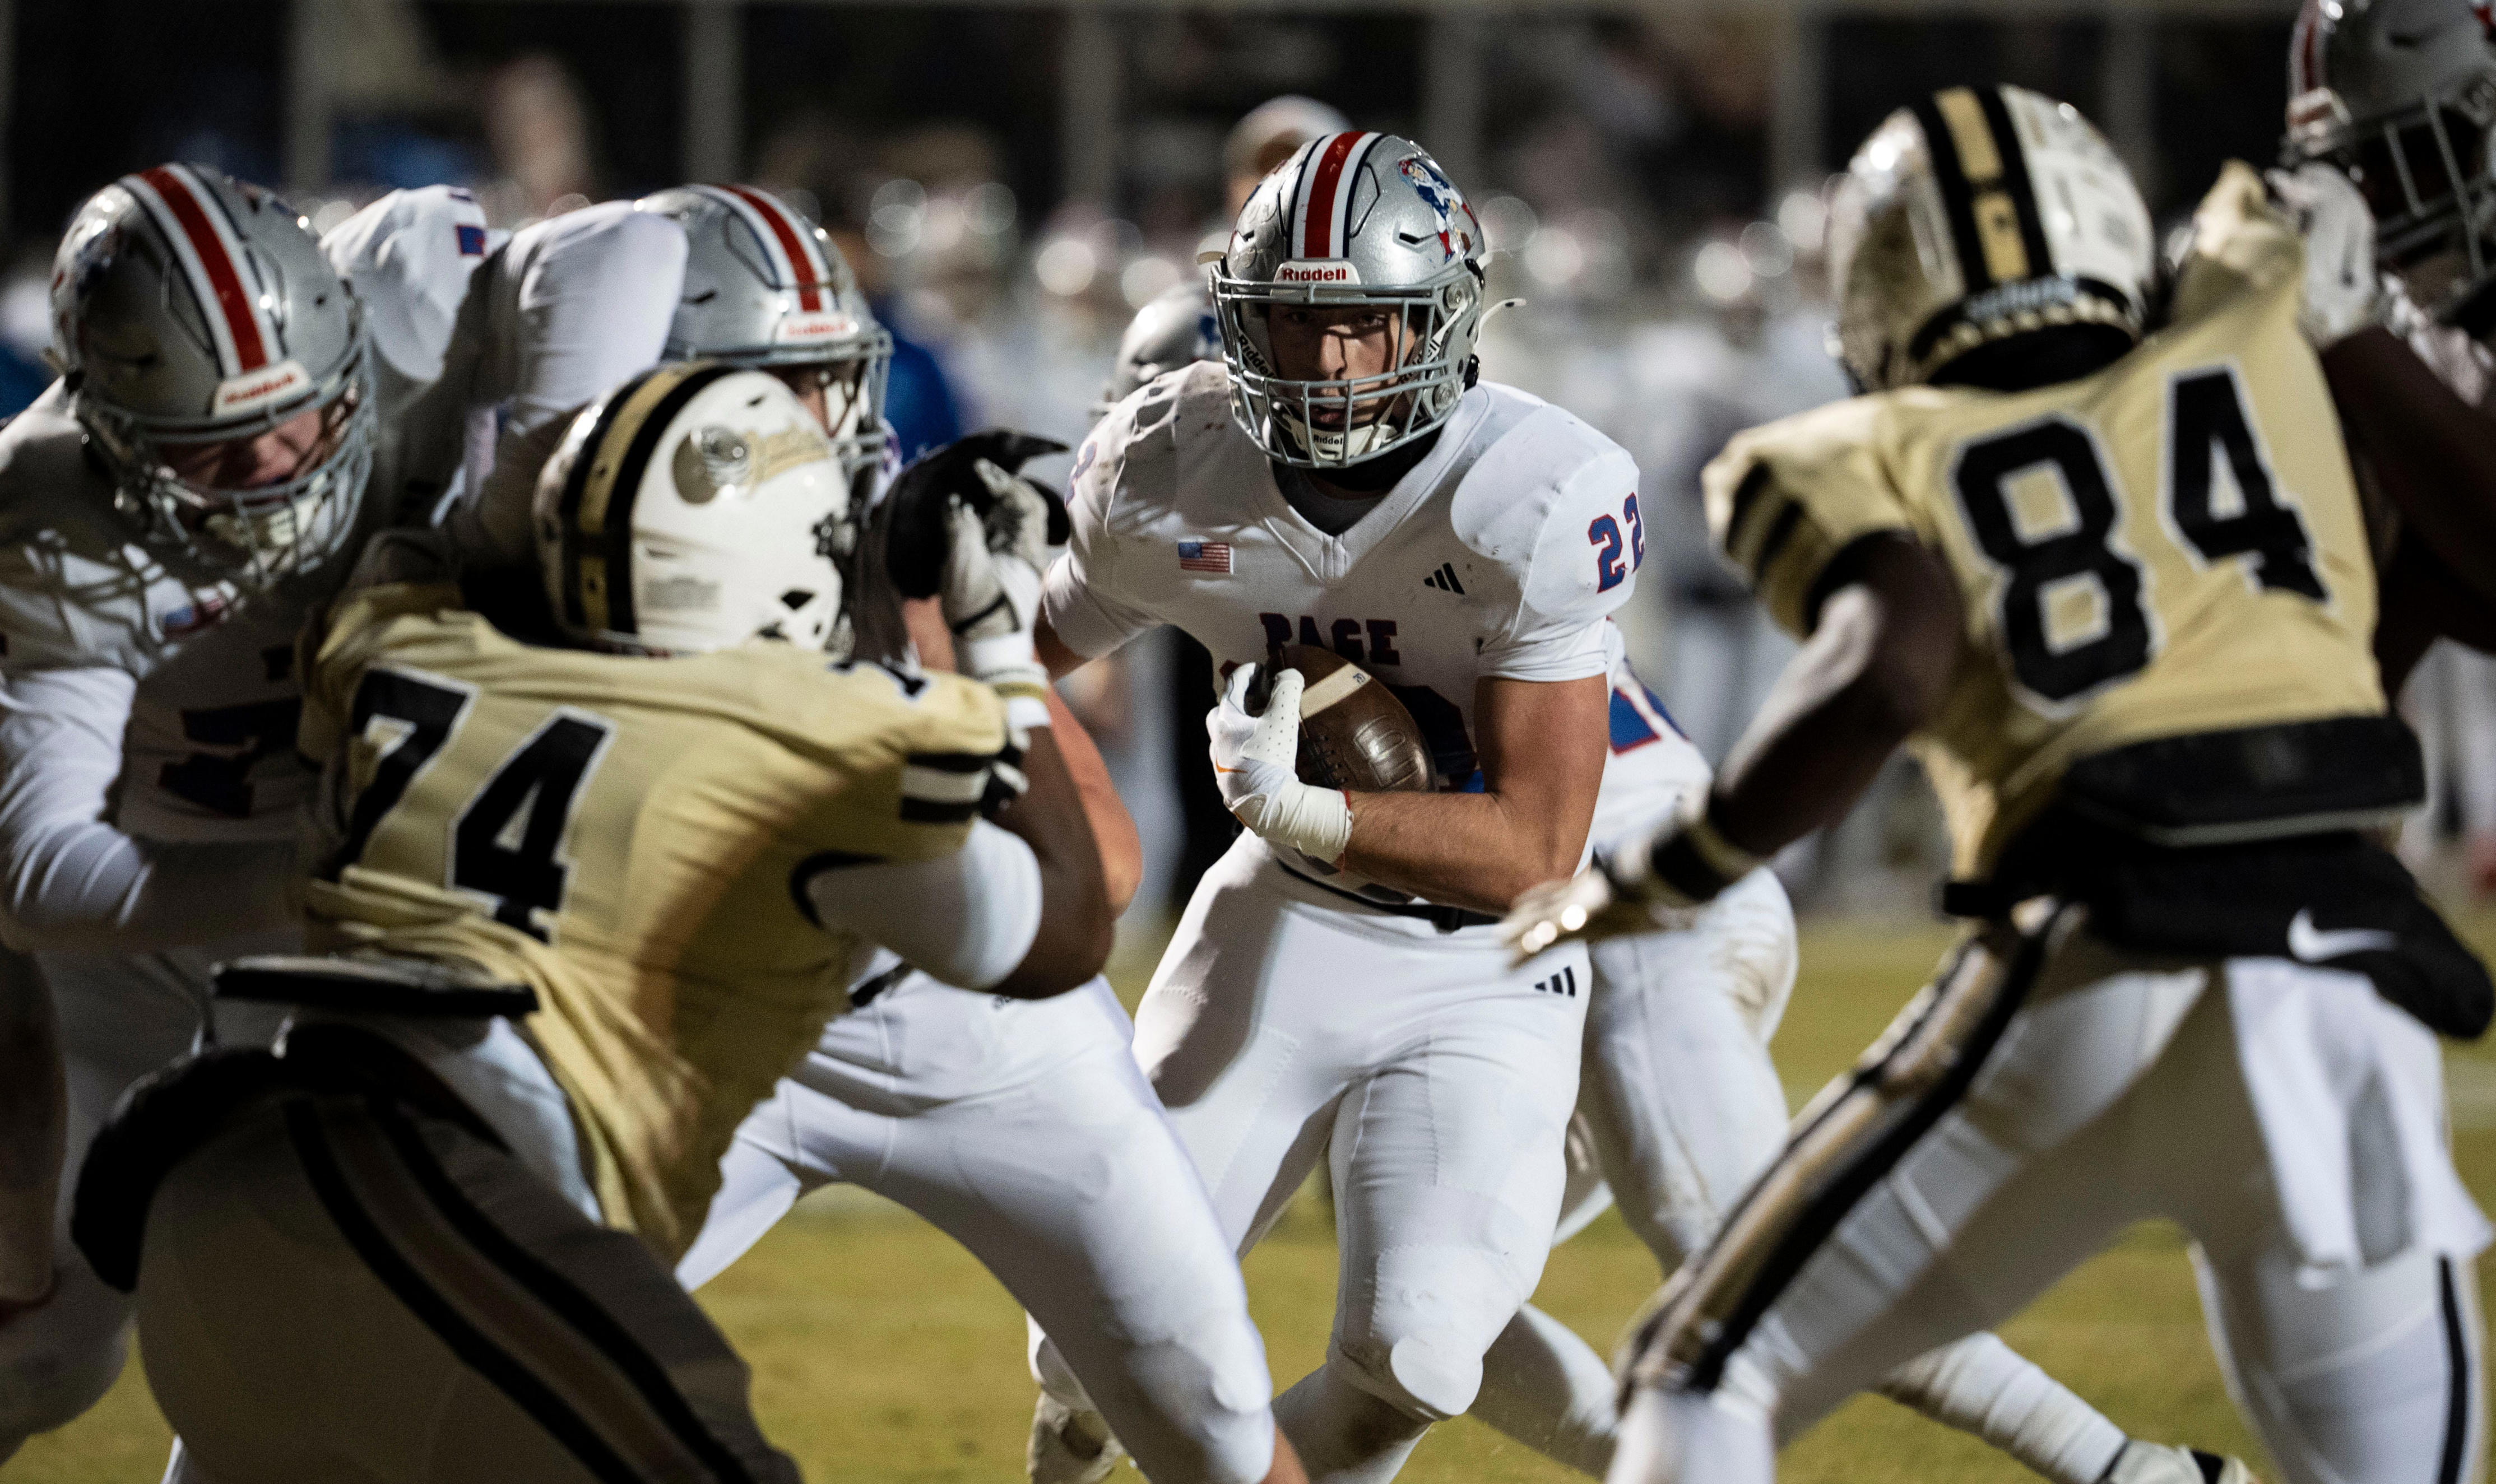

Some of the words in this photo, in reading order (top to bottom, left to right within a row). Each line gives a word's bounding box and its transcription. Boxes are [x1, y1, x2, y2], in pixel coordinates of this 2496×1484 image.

[1282, 267, 1346, 281] Riddell
[1588, 491, 1645, 594] 22
[1948, 361, 2338, 719] 84
[1259, 612, 1400, 666] PAGE
[336, 659, 616, 946] 74
